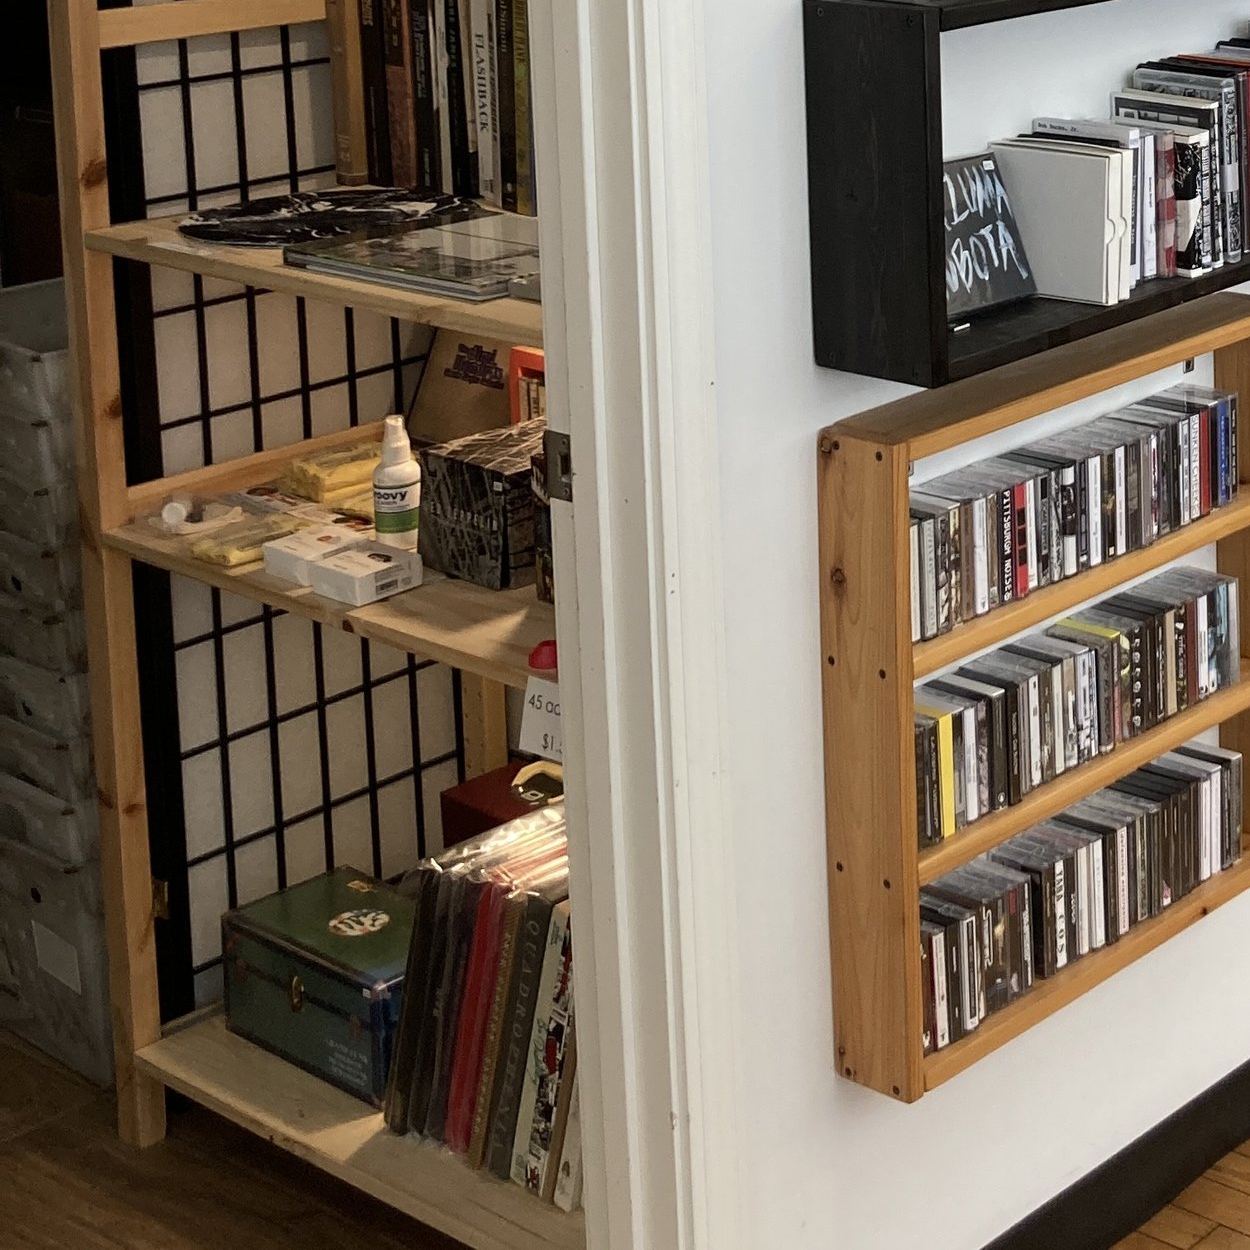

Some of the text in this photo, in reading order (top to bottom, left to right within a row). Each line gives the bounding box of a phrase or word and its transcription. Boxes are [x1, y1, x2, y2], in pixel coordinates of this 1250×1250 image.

[474, 33, 489, 132] FLASHBACK
[1191, 416, 1199, 463] SUNKEN
[453, 508, 498, 531] ZEPPELIN
[1003, 490, 1013, 591] PITTSBURGH NOISE
[528, 693, 543, 710] 45
[493, 919, 542, 1151] QUADROPHENIA
